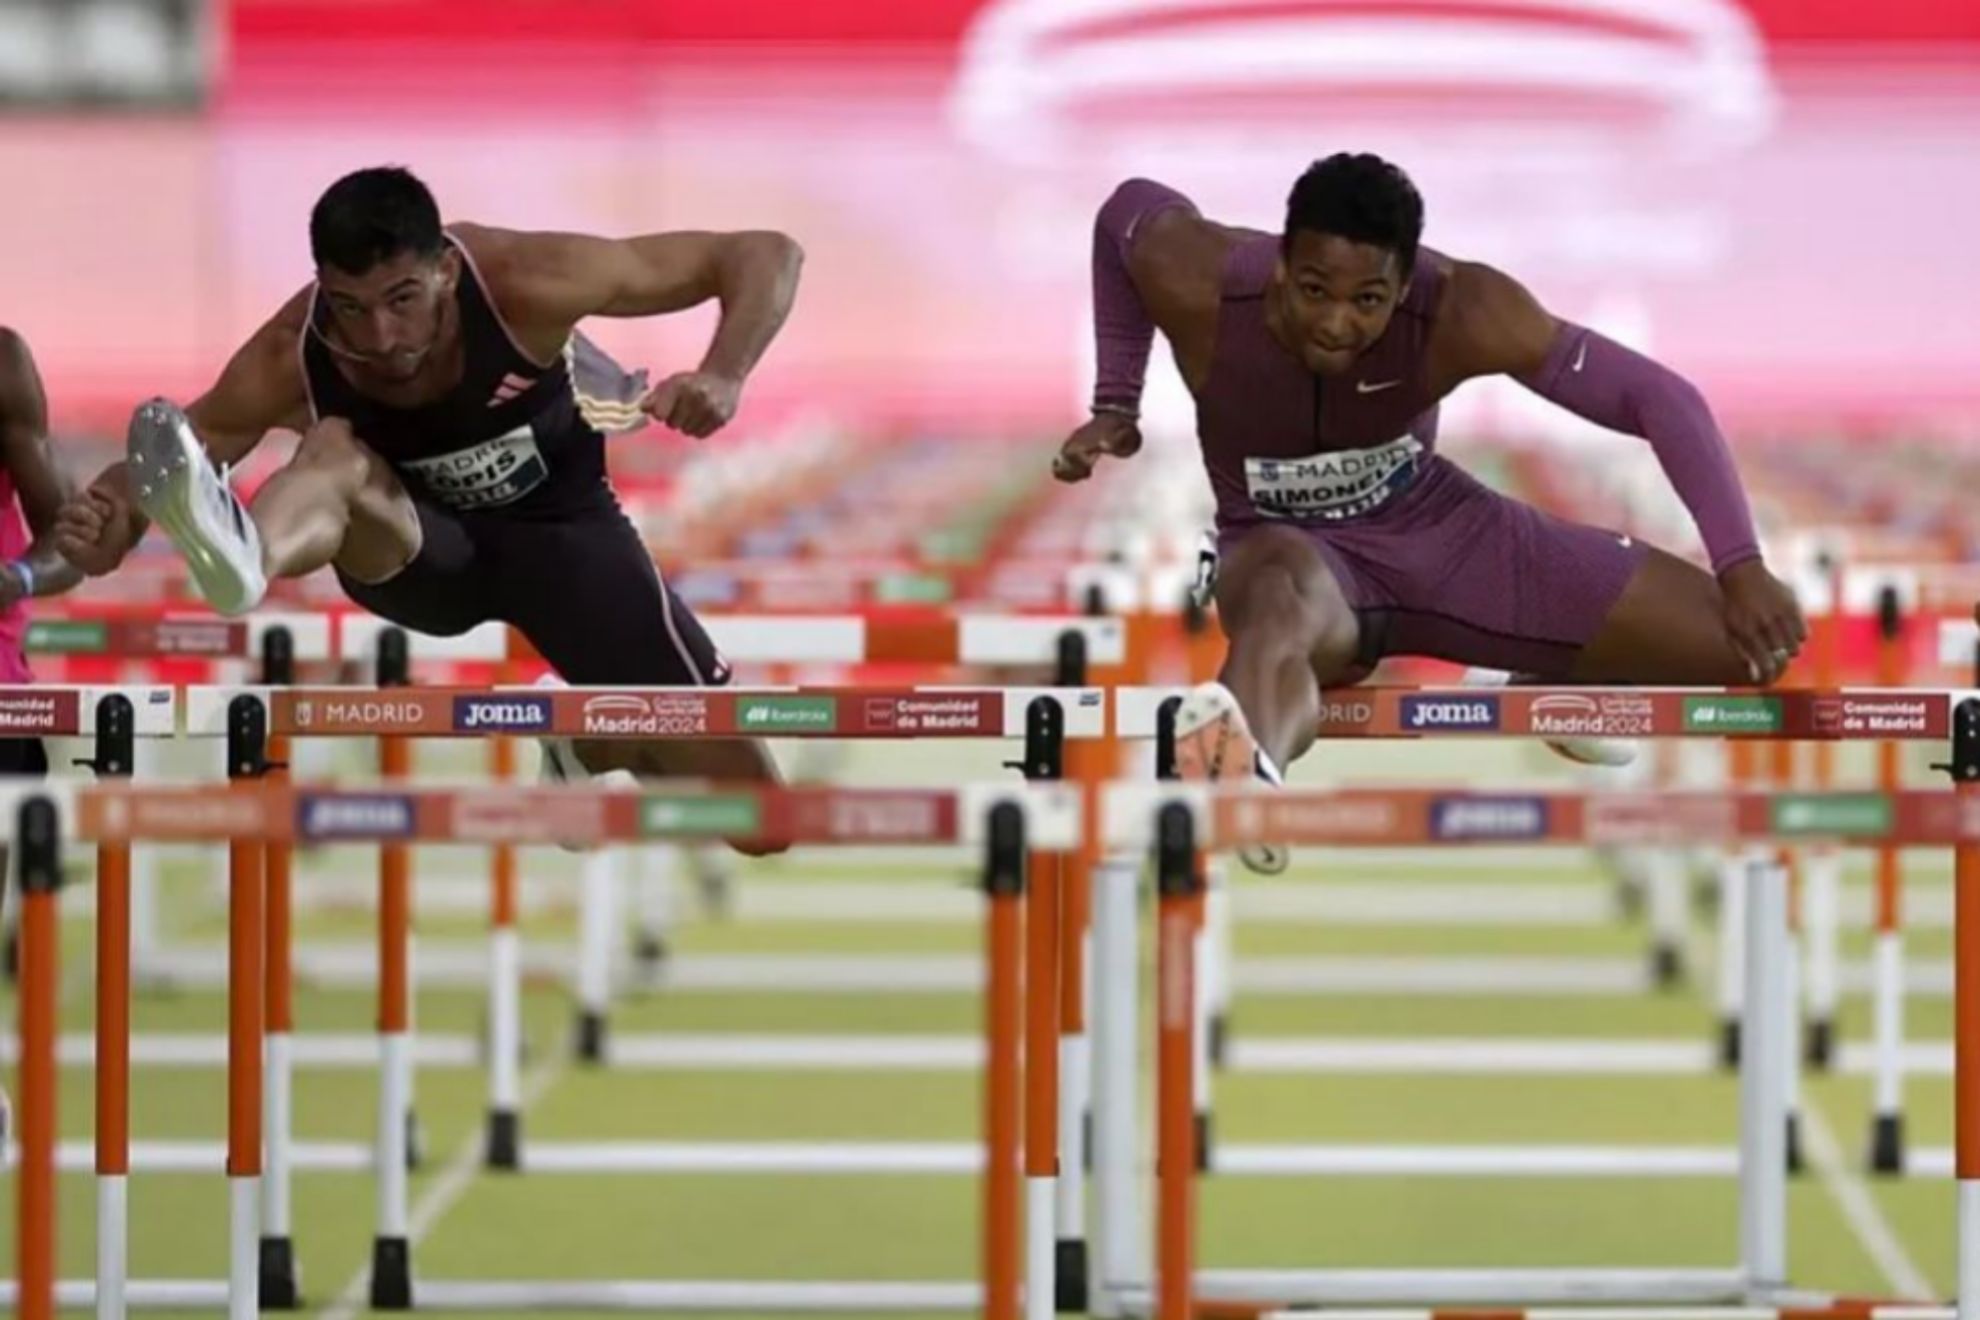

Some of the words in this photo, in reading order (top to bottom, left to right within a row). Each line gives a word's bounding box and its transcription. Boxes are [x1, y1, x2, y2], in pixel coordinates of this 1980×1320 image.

[326, 702, 423, 722] MADRID
[897, 699, 979, 713] Comunidad
[1843, 701, 1926, 715] Comunidad
[897, 715, 918, 729] de
[922, 714, 979, 729] Madrid
[1843, 716, 1864, 730] de
[1868, 716, 1926, 730] Madrid
